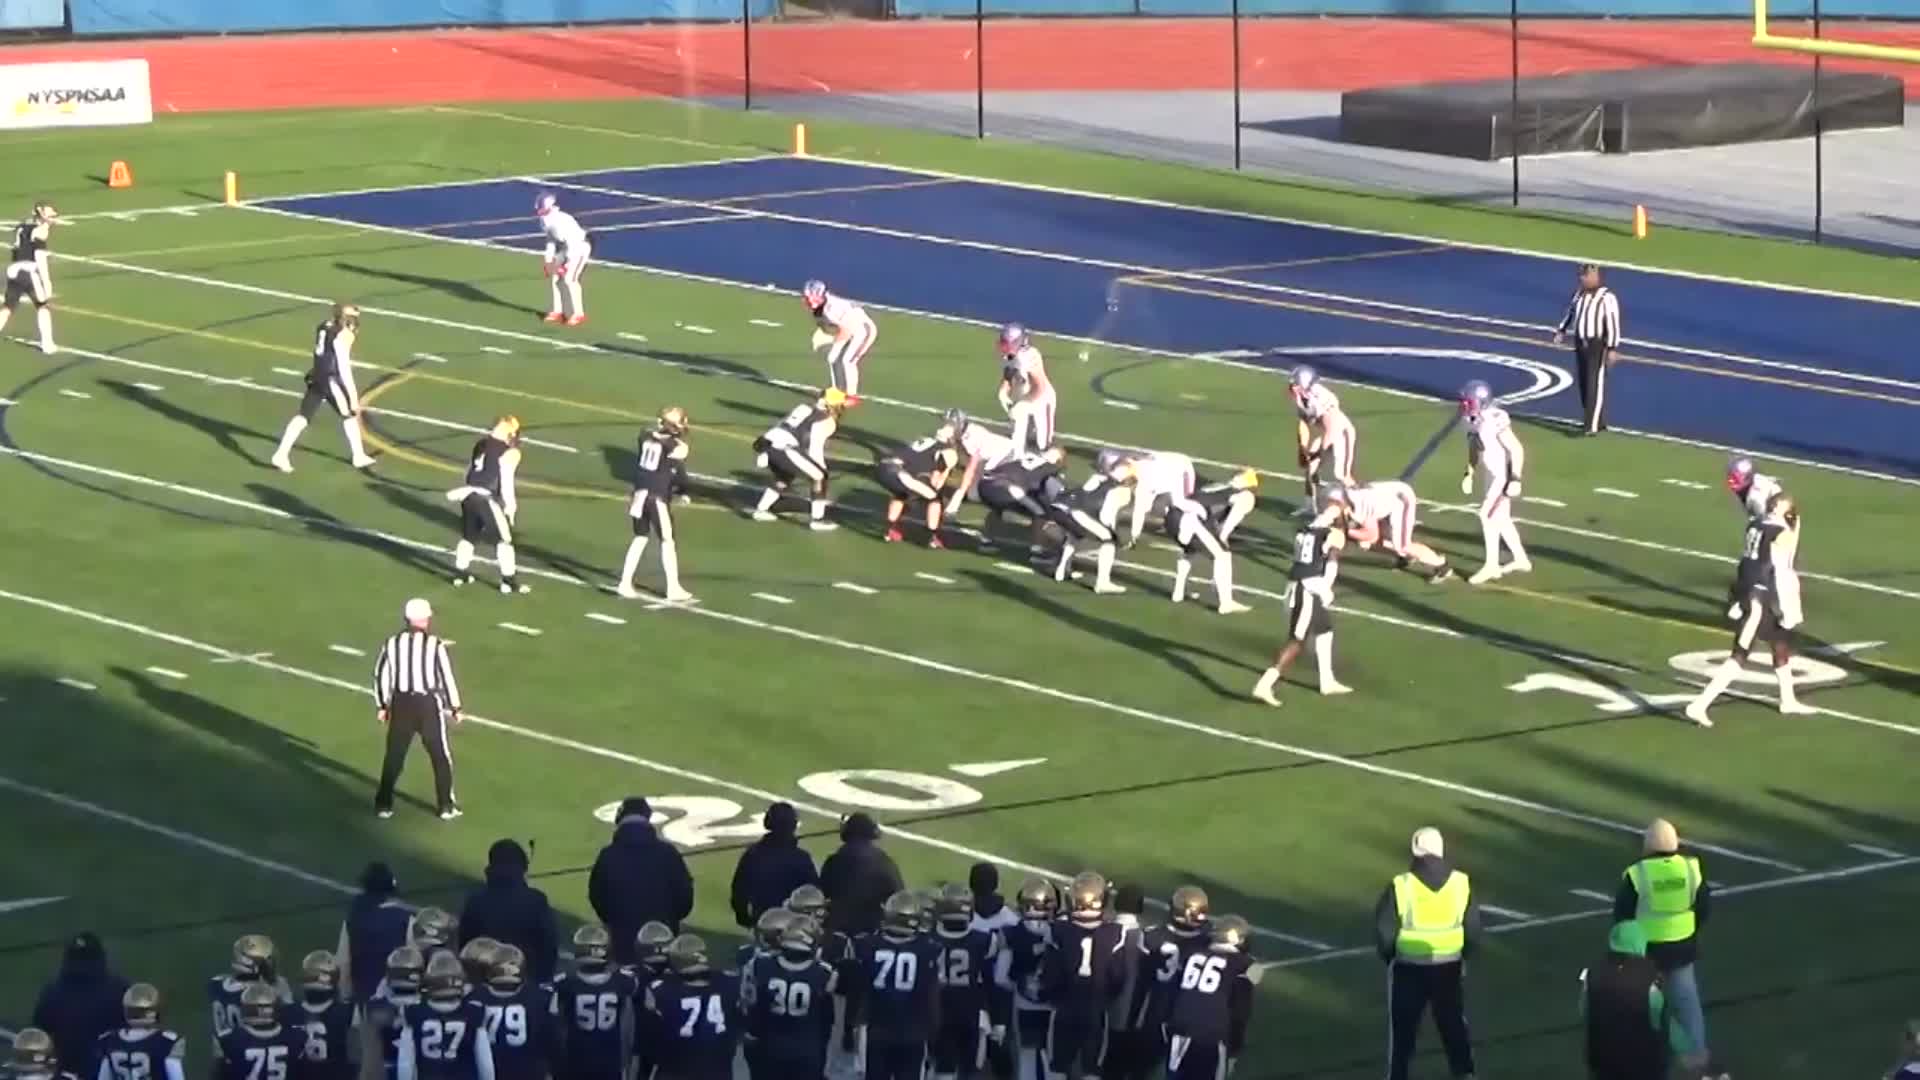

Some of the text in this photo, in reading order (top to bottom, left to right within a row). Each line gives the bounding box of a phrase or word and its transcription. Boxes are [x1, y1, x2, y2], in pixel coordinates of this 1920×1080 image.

[872, 950, 918, 990] 70
[1078, 936, 1093, 977] 1
[1181, 953, 1227, 993] 66
[575, 993, 618, 1031] 56
[679, 994, 727, 1038] 74
[767, 977, 811, 1017] 30
[420, 1019, 466, 1059] 27
[484, 1003, 527, 1047] 79
[245, 1046, 289, 1080] 75
